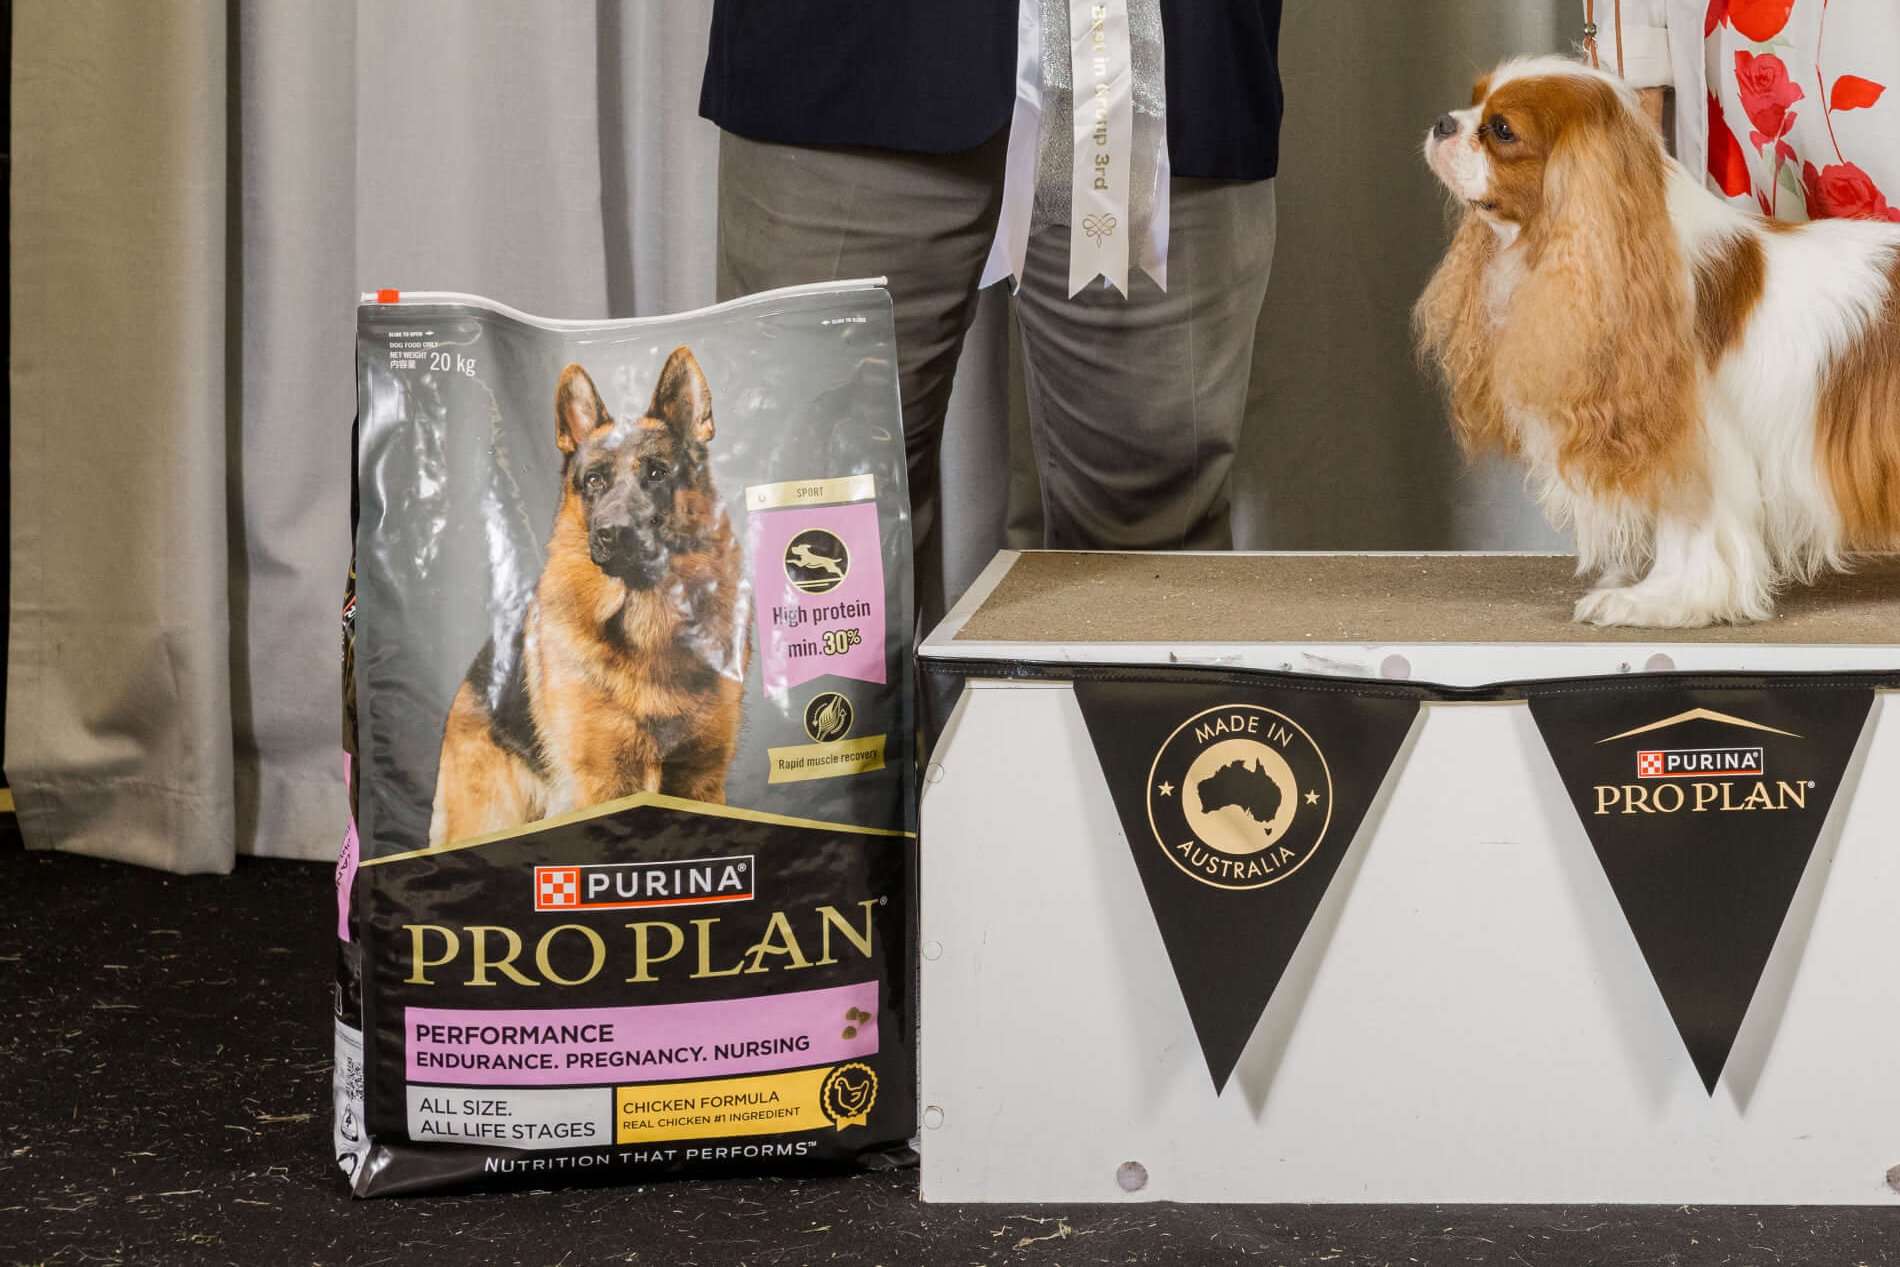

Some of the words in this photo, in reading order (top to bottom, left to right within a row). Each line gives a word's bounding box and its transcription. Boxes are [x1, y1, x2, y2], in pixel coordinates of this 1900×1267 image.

[1092, 57, 1110, 77] in
[1093, 153, 1110, 191] 3rd
[430, 352, 451, 372] 20
[457, 353, 477, 377] kg
[796, 487, 824, 498] SPORT
[772, 605, 807, 628] High
[813, 600, 871, 626] protein
[1194, 715, 1259, 744] MADE
[1266, 722, 1294, 748] IN
[778, 757, 805, 771] Rapid
[807, 753, 839, 767] muscle
[840, 748, 878, 763] recovery
[1593, 783, 1685, 815] PRO
[1176, 840, 1296, 879] AUSTRALIA
[401, 923, 606, 987] PRO
[415, 1023, 614, 1046] PERFORMANCE
[415, 1051, 559, 1070] ENDURANCE.
[566, 1046, 708, 1069] PREGNANCY.
[713, 1034, 811, 1062] NURSING
[419, 1097, 458, 1115] ALL
[463, 1099, 513, 1117] SIZE.
[623, 1098, 696, 1115] CHICKEN
[700, 1090, 780, 1109] FORMULA
[420, 1119, 459, 1136] ALL
[463, 1122, 508, 1139] LIFE
[511, 1121, 597, 1140] STAGES
[622, 1118, 654, 1130] REAL
[657, 1114, 711, 1128] CHICKEN
[713, 1113, 727, 1124] #1
[729, 1106, 801, 1122] INGREDIENT
[484, 1153, 610, 1173] NUTRITION
[619, 1149, 677, 1165] THAT
